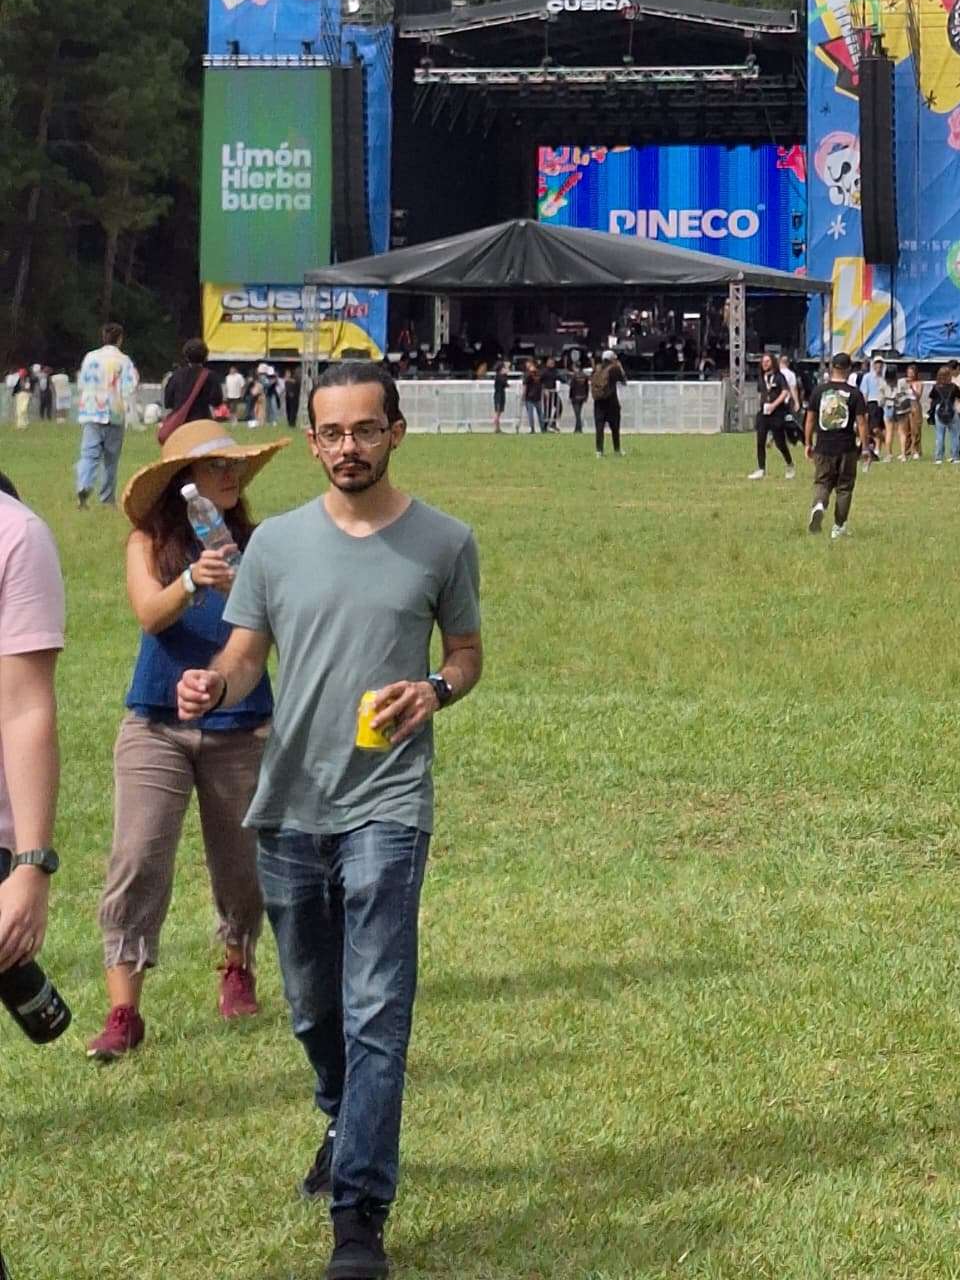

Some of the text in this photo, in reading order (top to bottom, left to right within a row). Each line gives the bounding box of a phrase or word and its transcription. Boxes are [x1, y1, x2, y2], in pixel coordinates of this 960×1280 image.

[222, 142, 311, 167] Limón
[222, 167, 311, 189] Hierba
[222, 189, 311, 210] buena
[609, 208, 760, 239] PINECO
